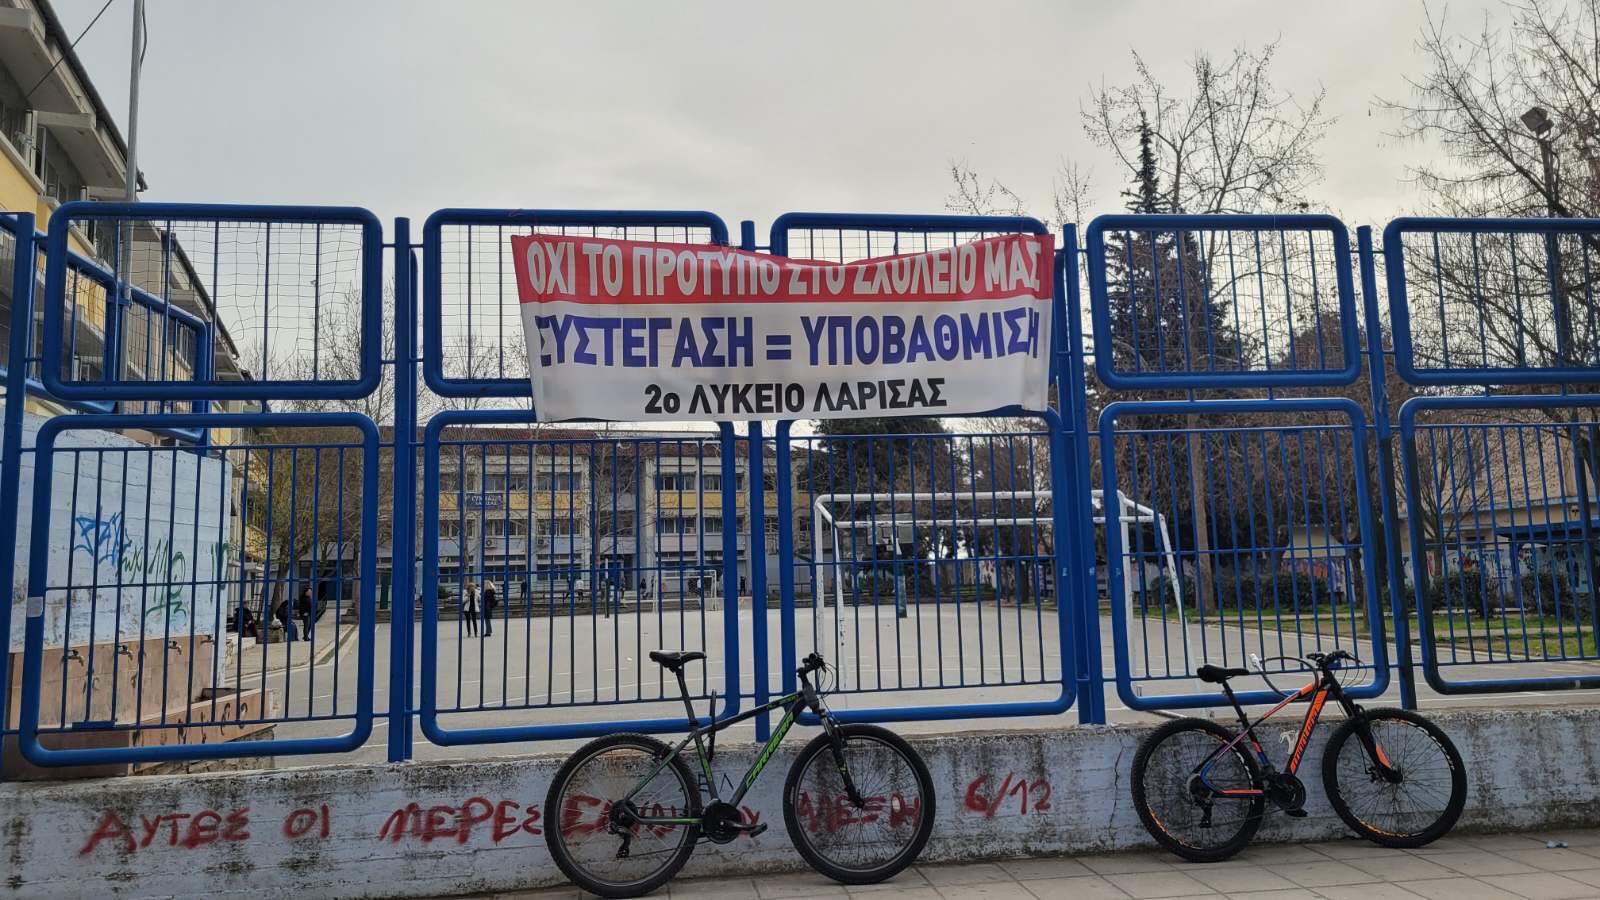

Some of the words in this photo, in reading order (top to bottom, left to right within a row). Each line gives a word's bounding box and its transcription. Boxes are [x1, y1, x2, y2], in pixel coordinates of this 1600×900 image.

[527, 241, 576, 295] ΟΧΙ
[582, 243, 623, 296] ΤΟ
[632, 246, 780, 296] ΠΡΟΤΥΠΟ
[984, 240, 1042, 292] ΜΑΣ
[534, 313, 754, 368] ΣΥΣΤΕΓΑΣΗ
[766, 334, 791, 360] =
[800, 307, 1039, 366] ΥΠΟΒΑΘΜΙΣΗ
[688, 383, 805, 414] ΛΥΚΕΙΟ
[813, 378, 948, 412] ΛΑΡΙΣΑΣ
[80, 808, 250, 854] ΑΥΤΕΣ
[283, 803, 330, 839] ΟΙ
[379, 797, 543, 845] ΜΕΡΕΣ
[965, 768, 1052, 816] 6/12
